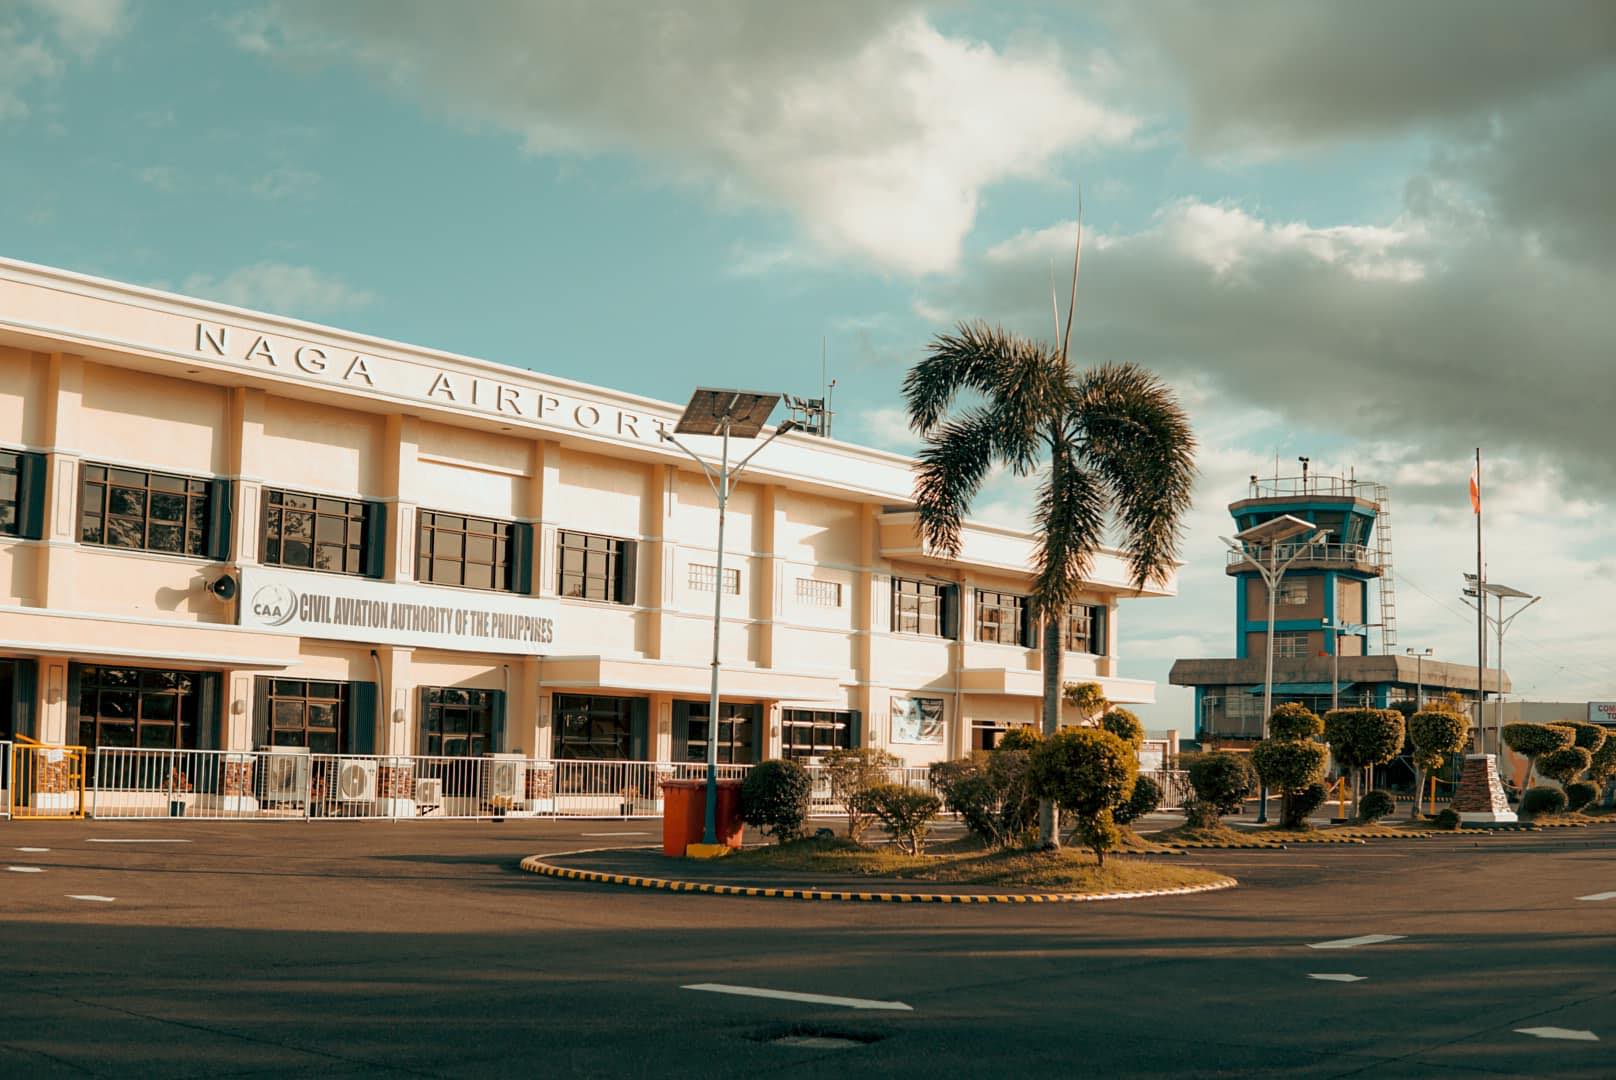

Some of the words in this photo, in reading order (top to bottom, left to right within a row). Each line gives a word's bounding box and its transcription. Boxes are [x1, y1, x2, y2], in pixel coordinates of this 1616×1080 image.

[196, 323, 373, 386] NAGA
[427, 372, 673, 443] AIRPORT
[253, 604, 282, 617] CAA
[300, 593, 331, 624] CIVIL
[333, 597, 388, 629] AVIATION
[390, 602, 453, 635] AUTHORITY
[455, 608, 468, 636] OF
[470, 610, 489, 637] THE
[491, 612, 553, 643] PHILIPPINES
